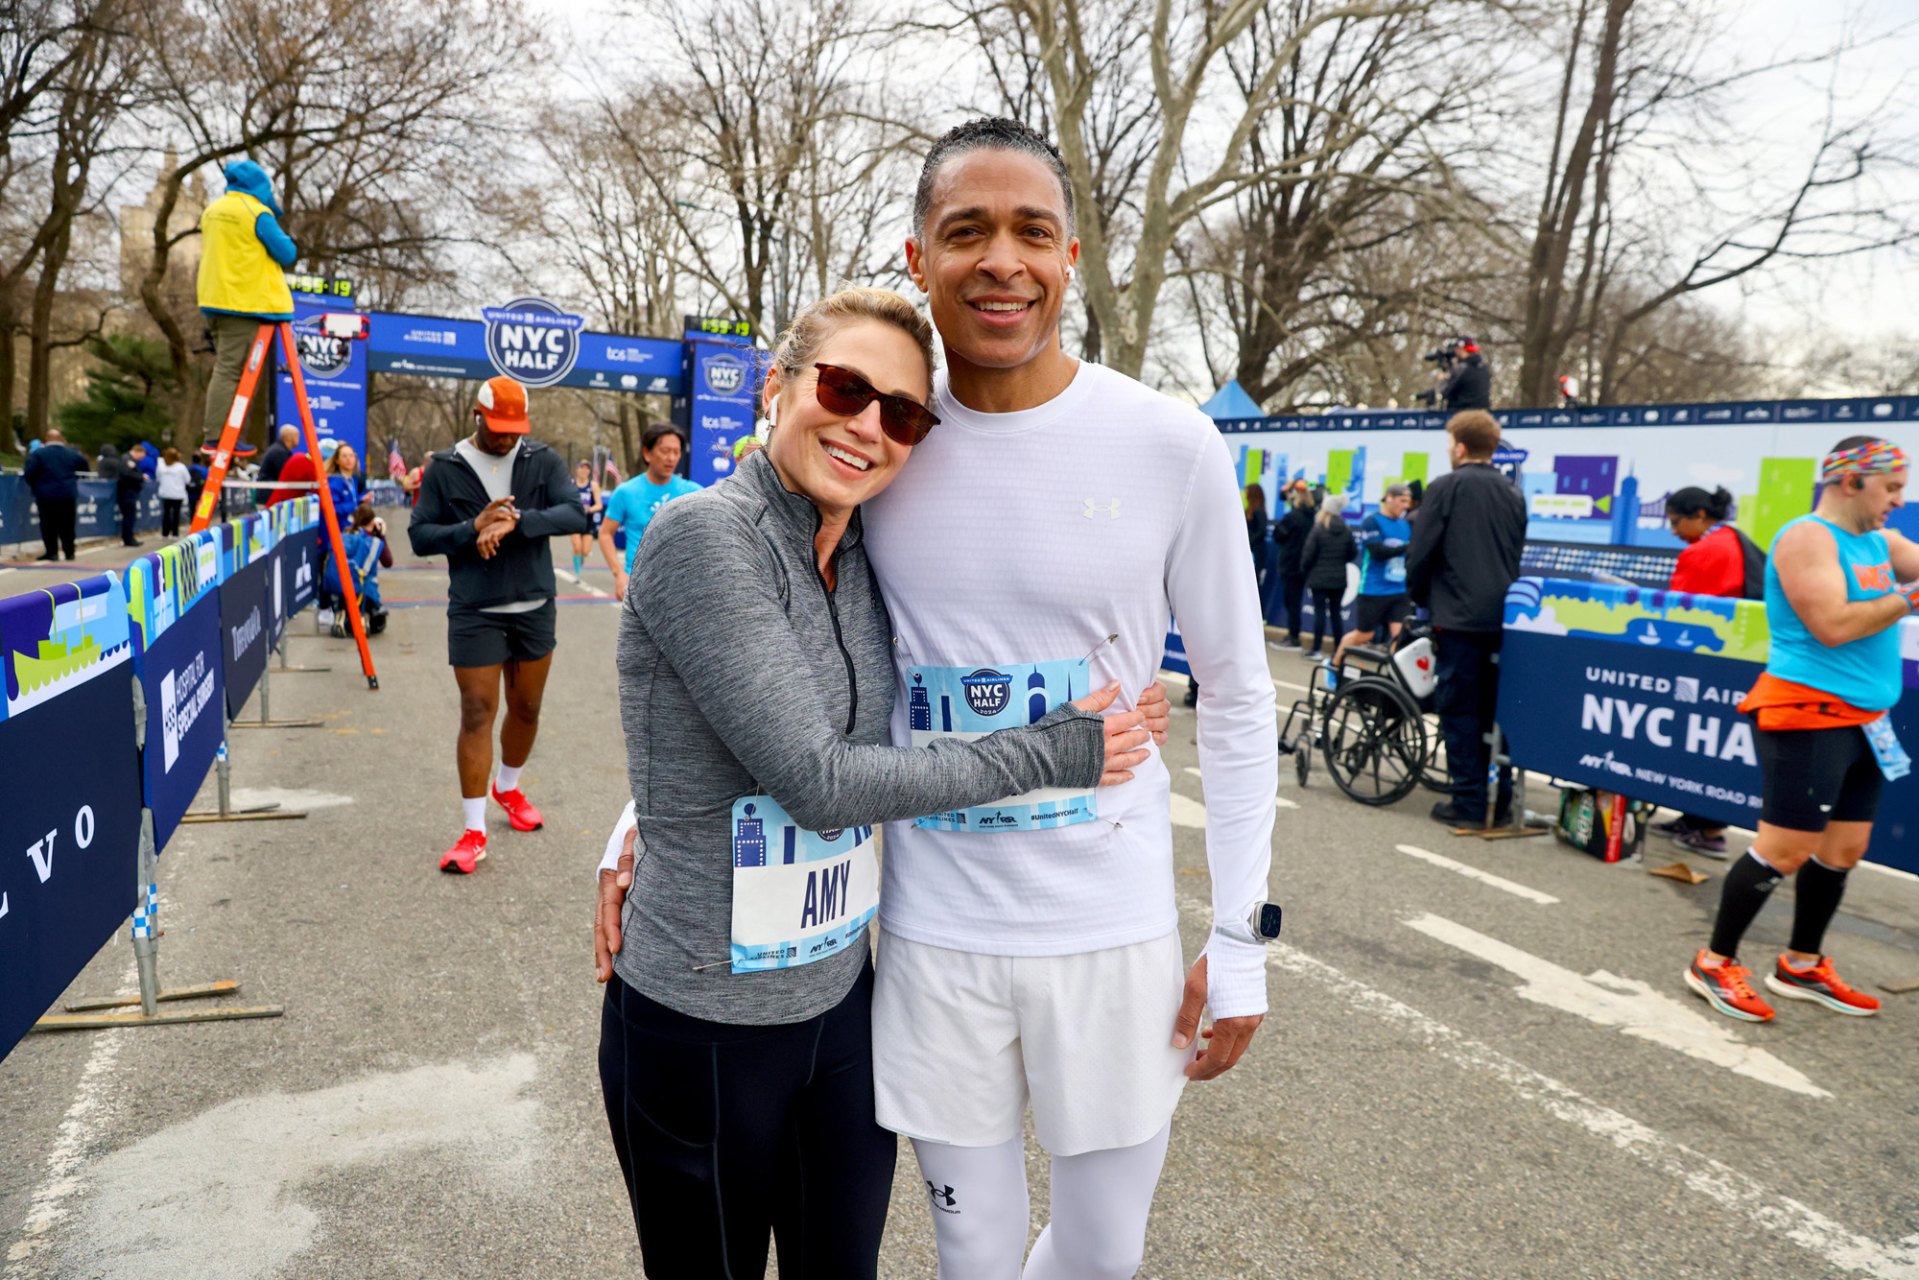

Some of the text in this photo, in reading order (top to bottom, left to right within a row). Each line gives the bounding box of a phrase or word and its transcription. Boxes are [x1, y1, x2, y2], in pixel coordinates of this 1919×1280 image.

[500, 324, 564, 353] NYC
[504, 349, 559, 370] HALF
[711, 366, 739, 381] NYC
[195, 650, 205, 679] FOR
[970, 683, 1003, 698] NYC
[1586, 666, 1748, 706] UNITED AIR
[177, 667, 215, 742] SPECIAL SURGERY
[973, 697, 1001, 707] HALF
[164, 703, 175, 740] HSS
[1581, 693, 1758, 767] NYC HA
[1635, 768, 1667, 785] NEW
[1668, 775, 1704, 795] YORK
[1705, 785, 1747, 805] ROAD
[800, 859, 851, 930] AMY
[757, 949, 785, 957] UNITED
